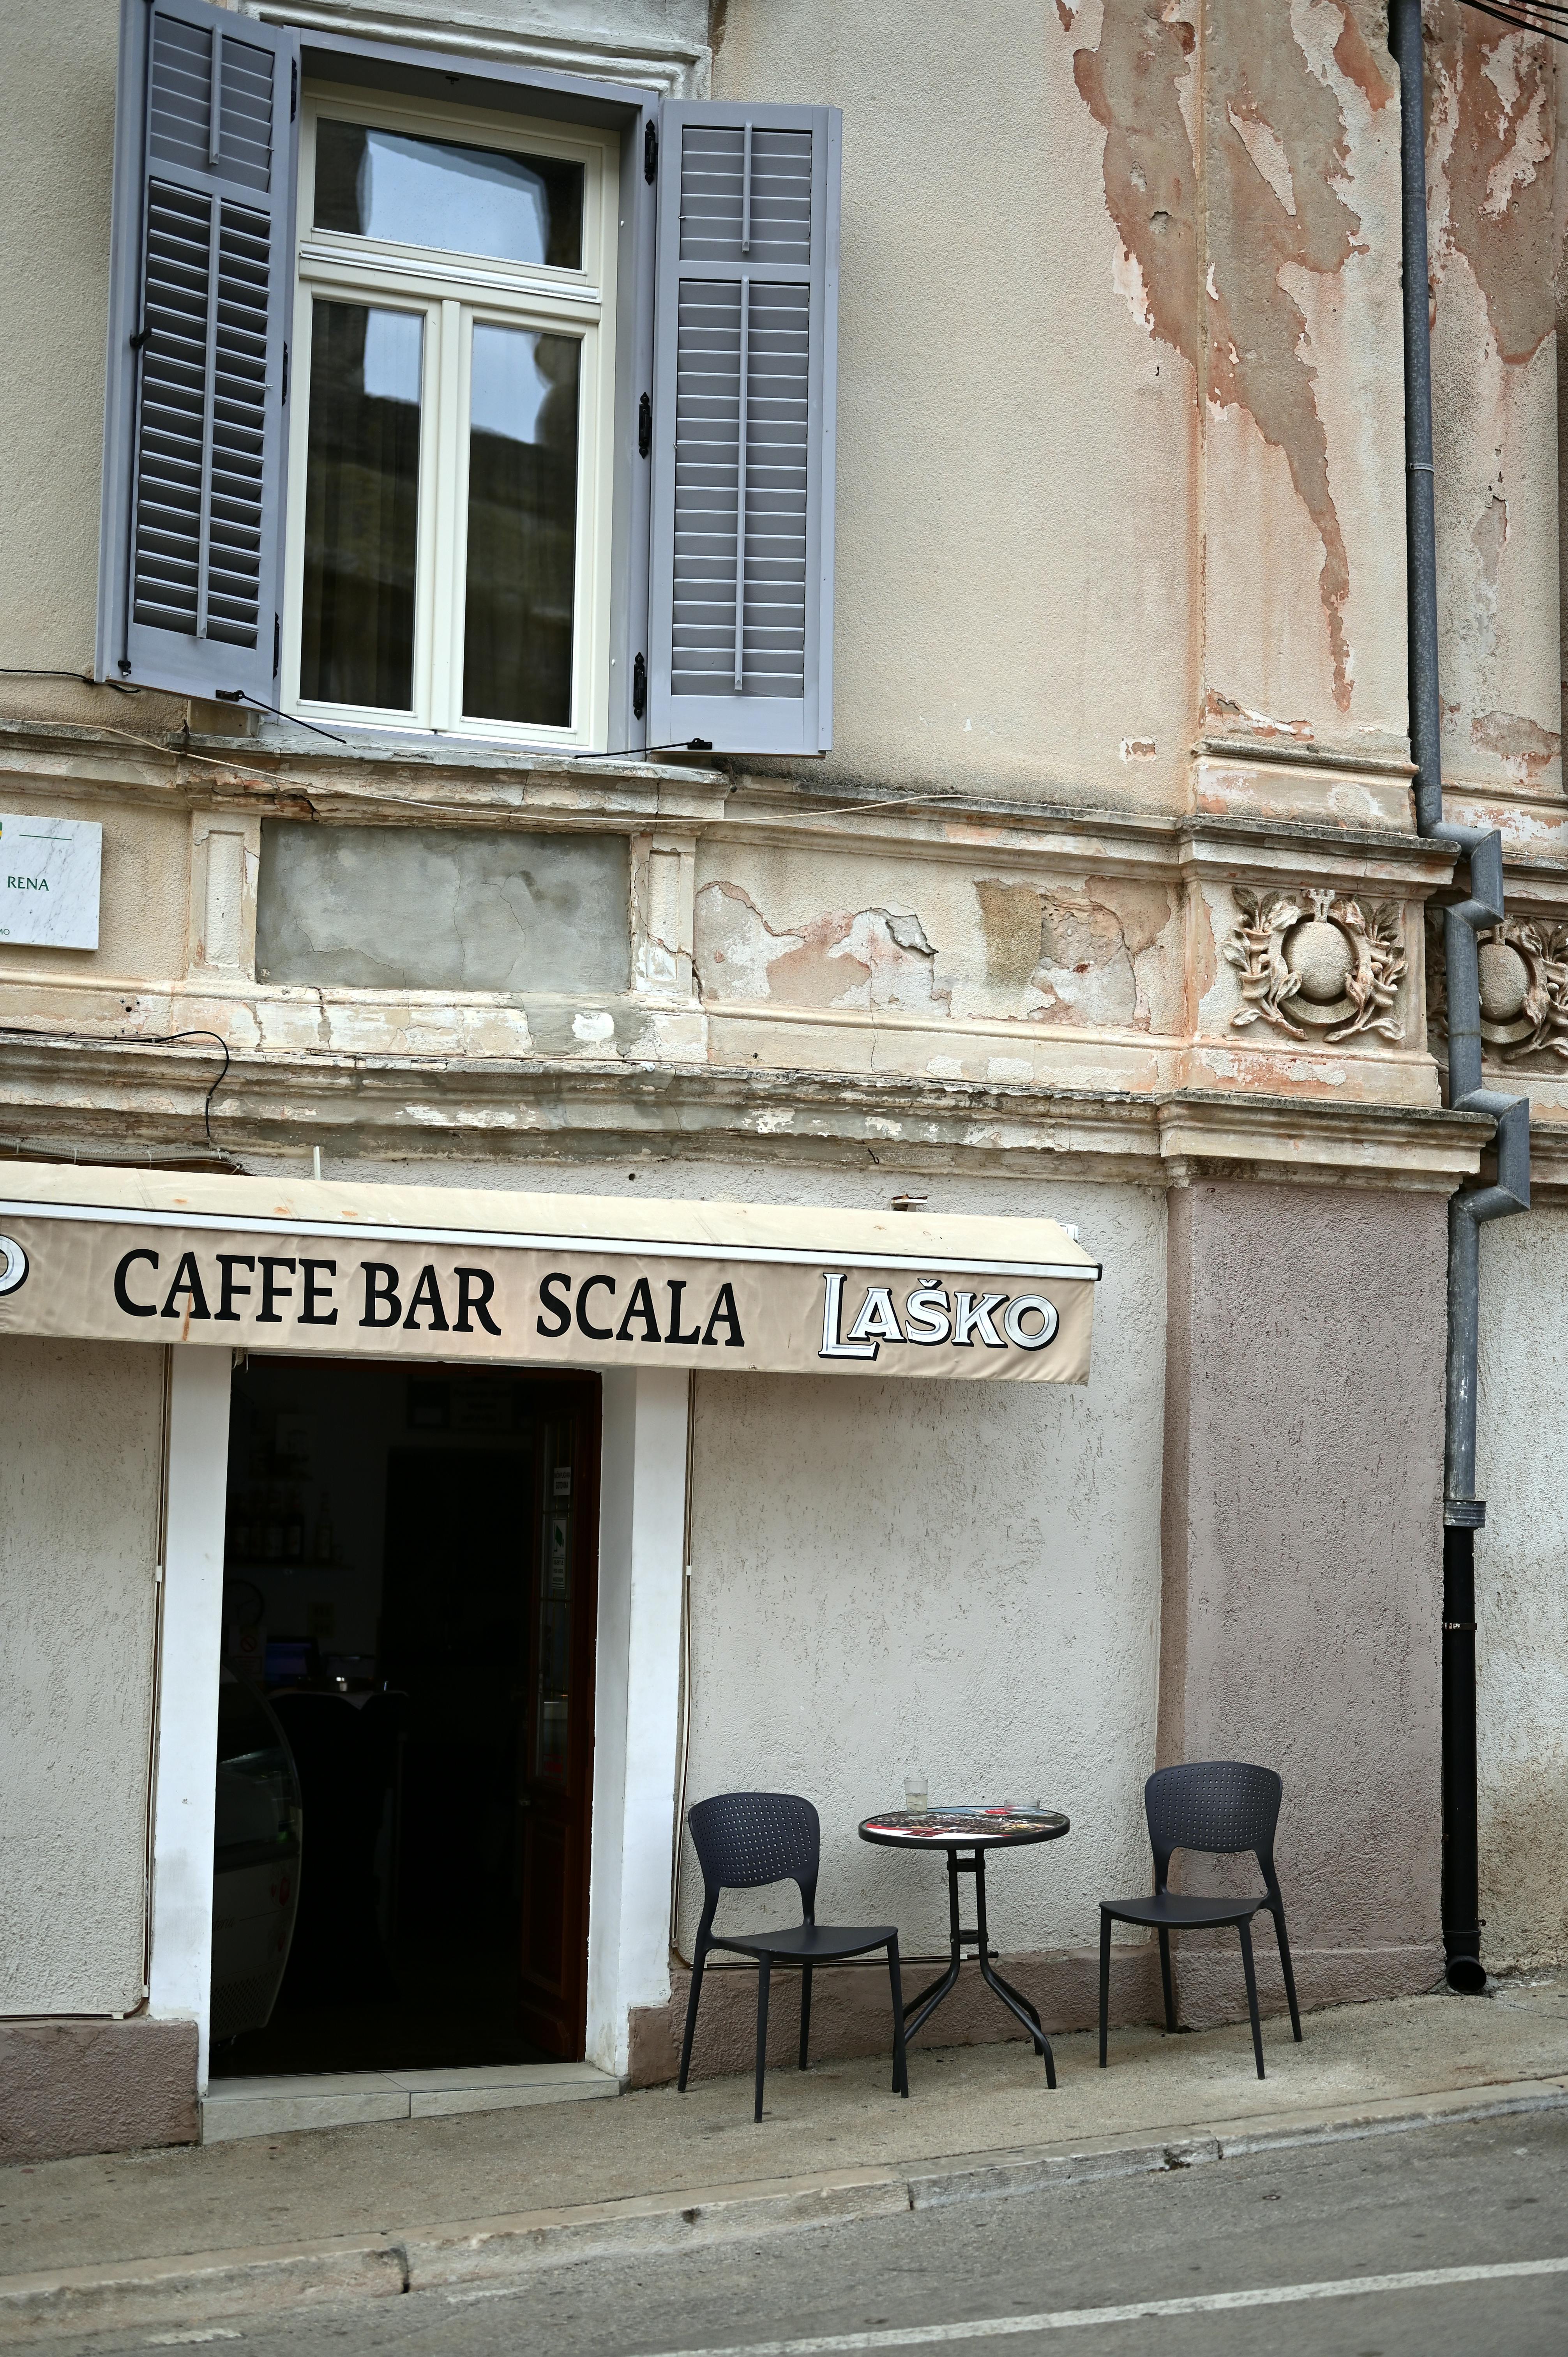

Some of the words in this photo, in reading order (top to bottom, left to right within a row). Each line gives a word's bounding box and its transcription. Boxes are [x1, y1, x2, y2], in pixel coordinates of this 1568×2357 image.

[7, 876, 49, 891] RENA
[114, 1249, 338, 1325] CAFFE
[359, 1262, 501, 1336] BAR
[536, 1272, 745, 1347] SCALA
[818, 1272, 1059, 1361] LAŠKO
